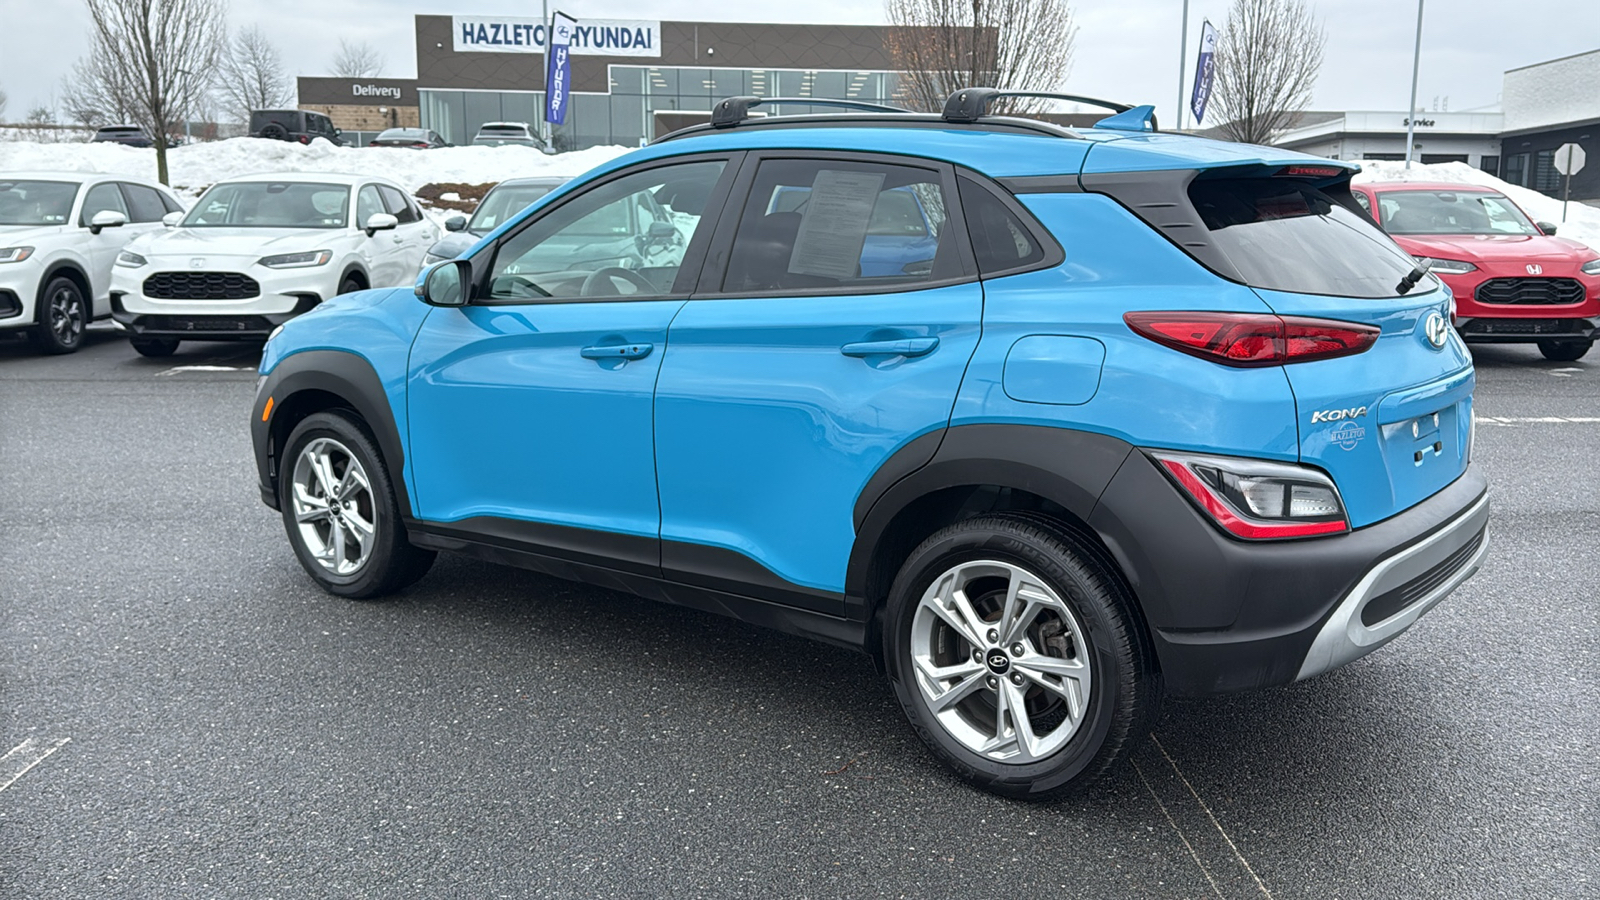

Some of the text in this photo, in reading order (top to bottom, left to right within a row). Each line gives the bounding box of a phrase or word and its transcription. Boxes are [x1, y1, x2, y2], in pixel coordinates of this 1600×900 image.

[462, 22, 652, 49] HAZLETO HYUNDAI
[352, 84, 401, 99] Delivery
[552, 48, 567, 121] HYUNDAI
[1194, 55, 1213, 116] HYUNDA
[1403, 117, 1435, 127] Srvice
[1311, 406, 1367, 424] KONA
[1331, 428, 1366, 441] HAZLETON
